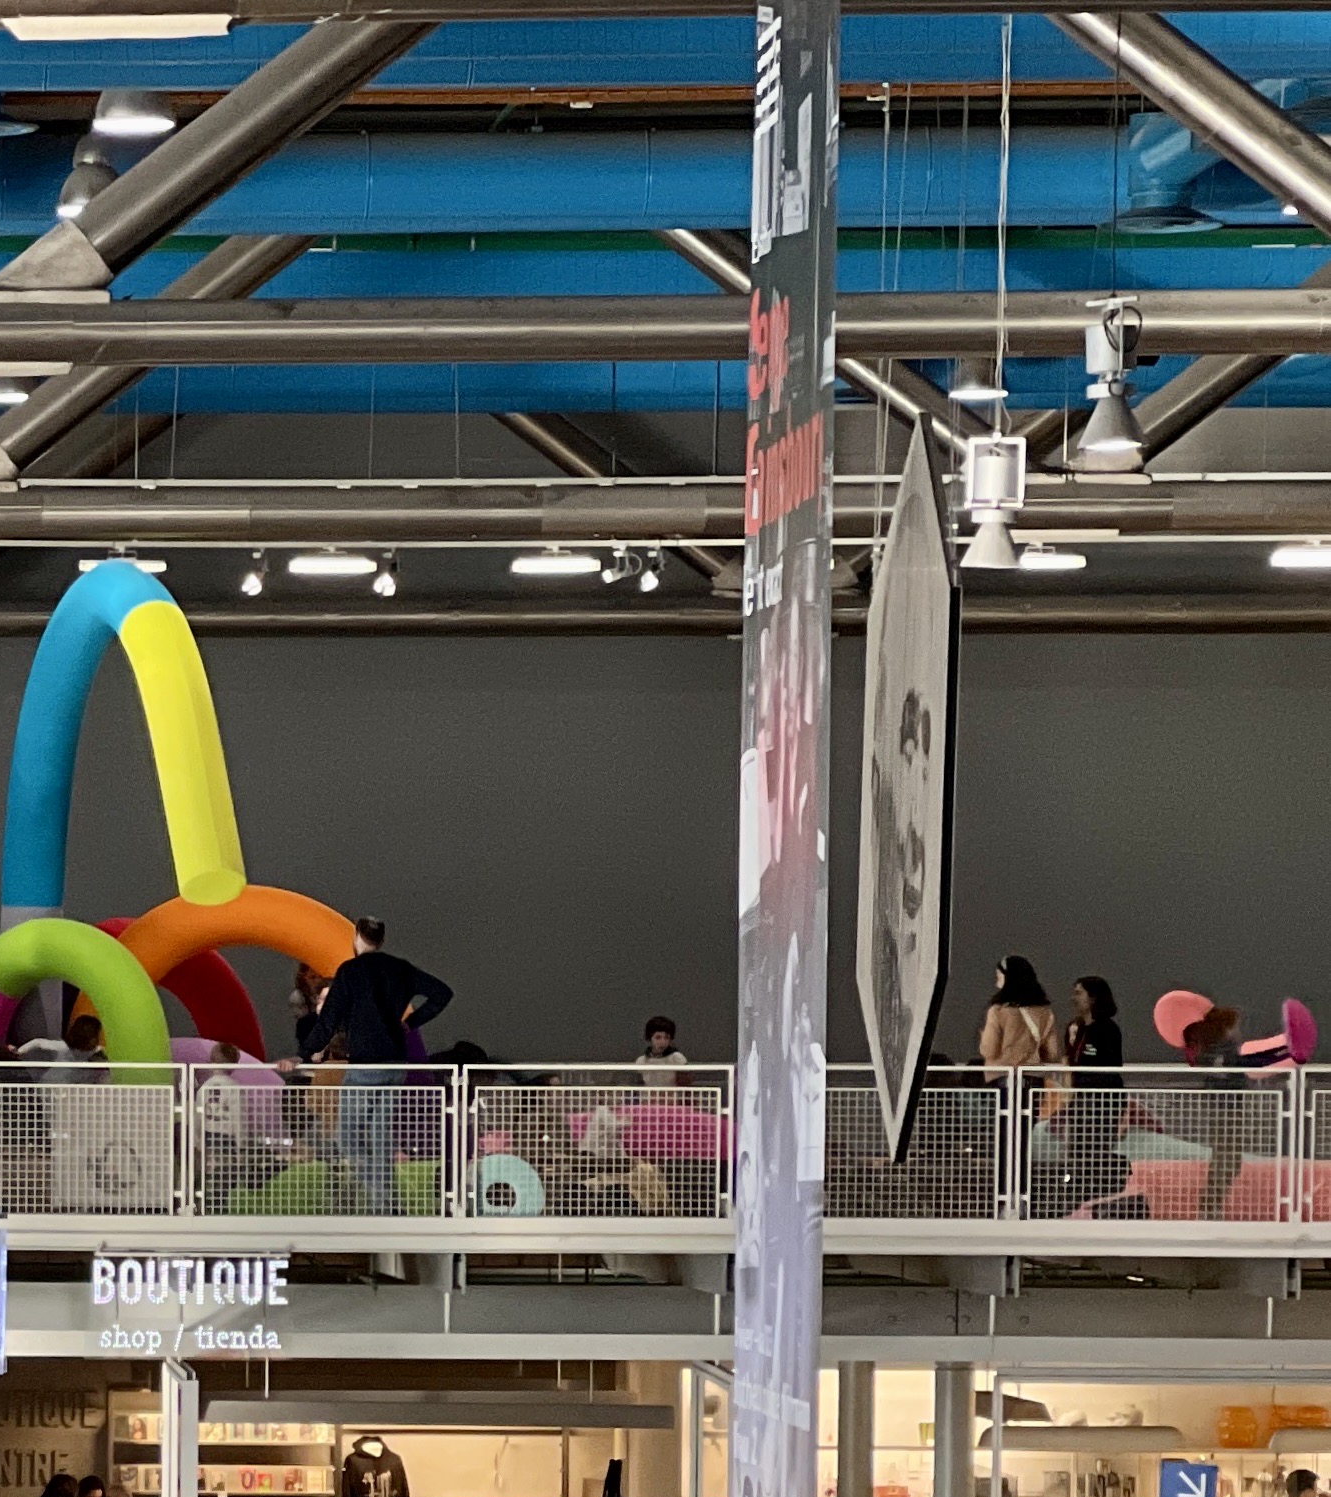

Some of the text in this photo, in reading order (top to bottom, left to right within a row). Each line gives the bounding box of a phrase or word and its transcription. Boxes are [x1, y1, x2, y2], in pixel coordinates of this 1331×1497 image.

[92, 1259, 289, 1305] BOUTIQUE
[100, 1323, 162, 1355] shop
[194, 1324, 282, 1349] tienda
